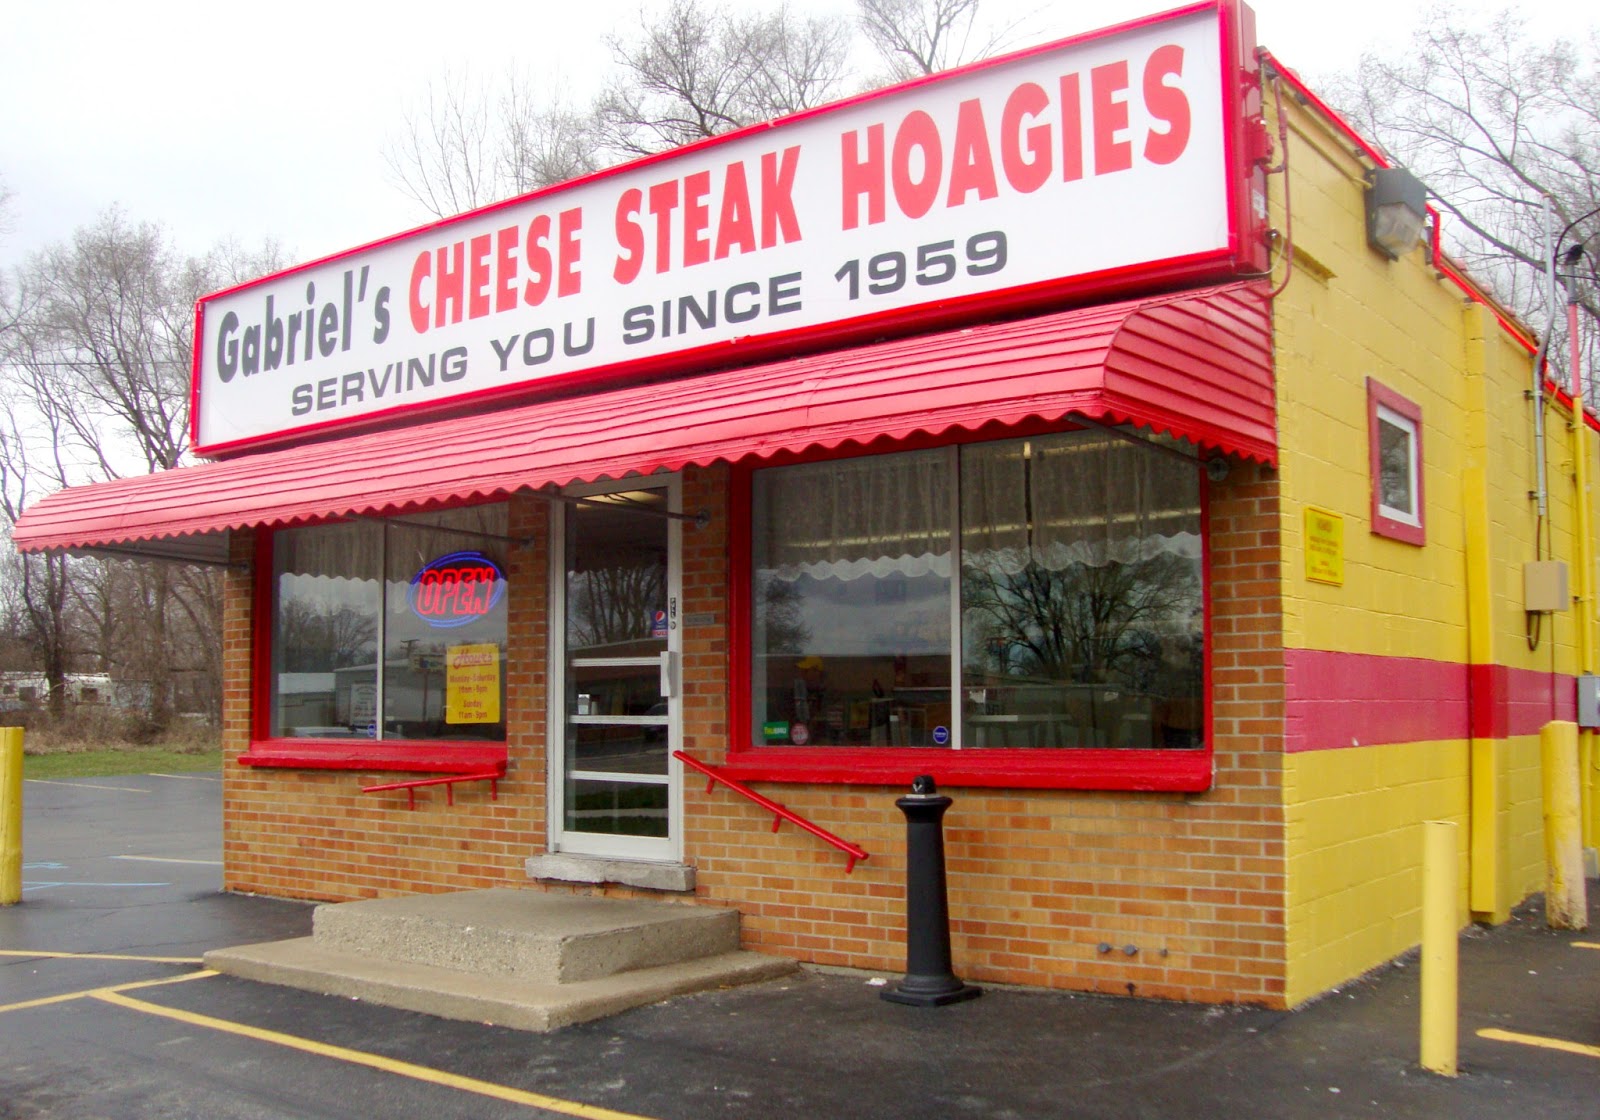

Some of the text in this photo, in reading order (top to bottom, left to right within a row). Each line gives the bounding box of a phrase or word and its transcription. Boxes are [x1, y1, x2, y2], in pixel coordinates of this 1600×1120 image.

[217, 44, 1192, 384] Gabriel's CHEESE STEAK HOAGIES
[291, 230, 1009, 417] SERVING YOU SINCE 1959
[417, 567, 495, 615] OPEN
